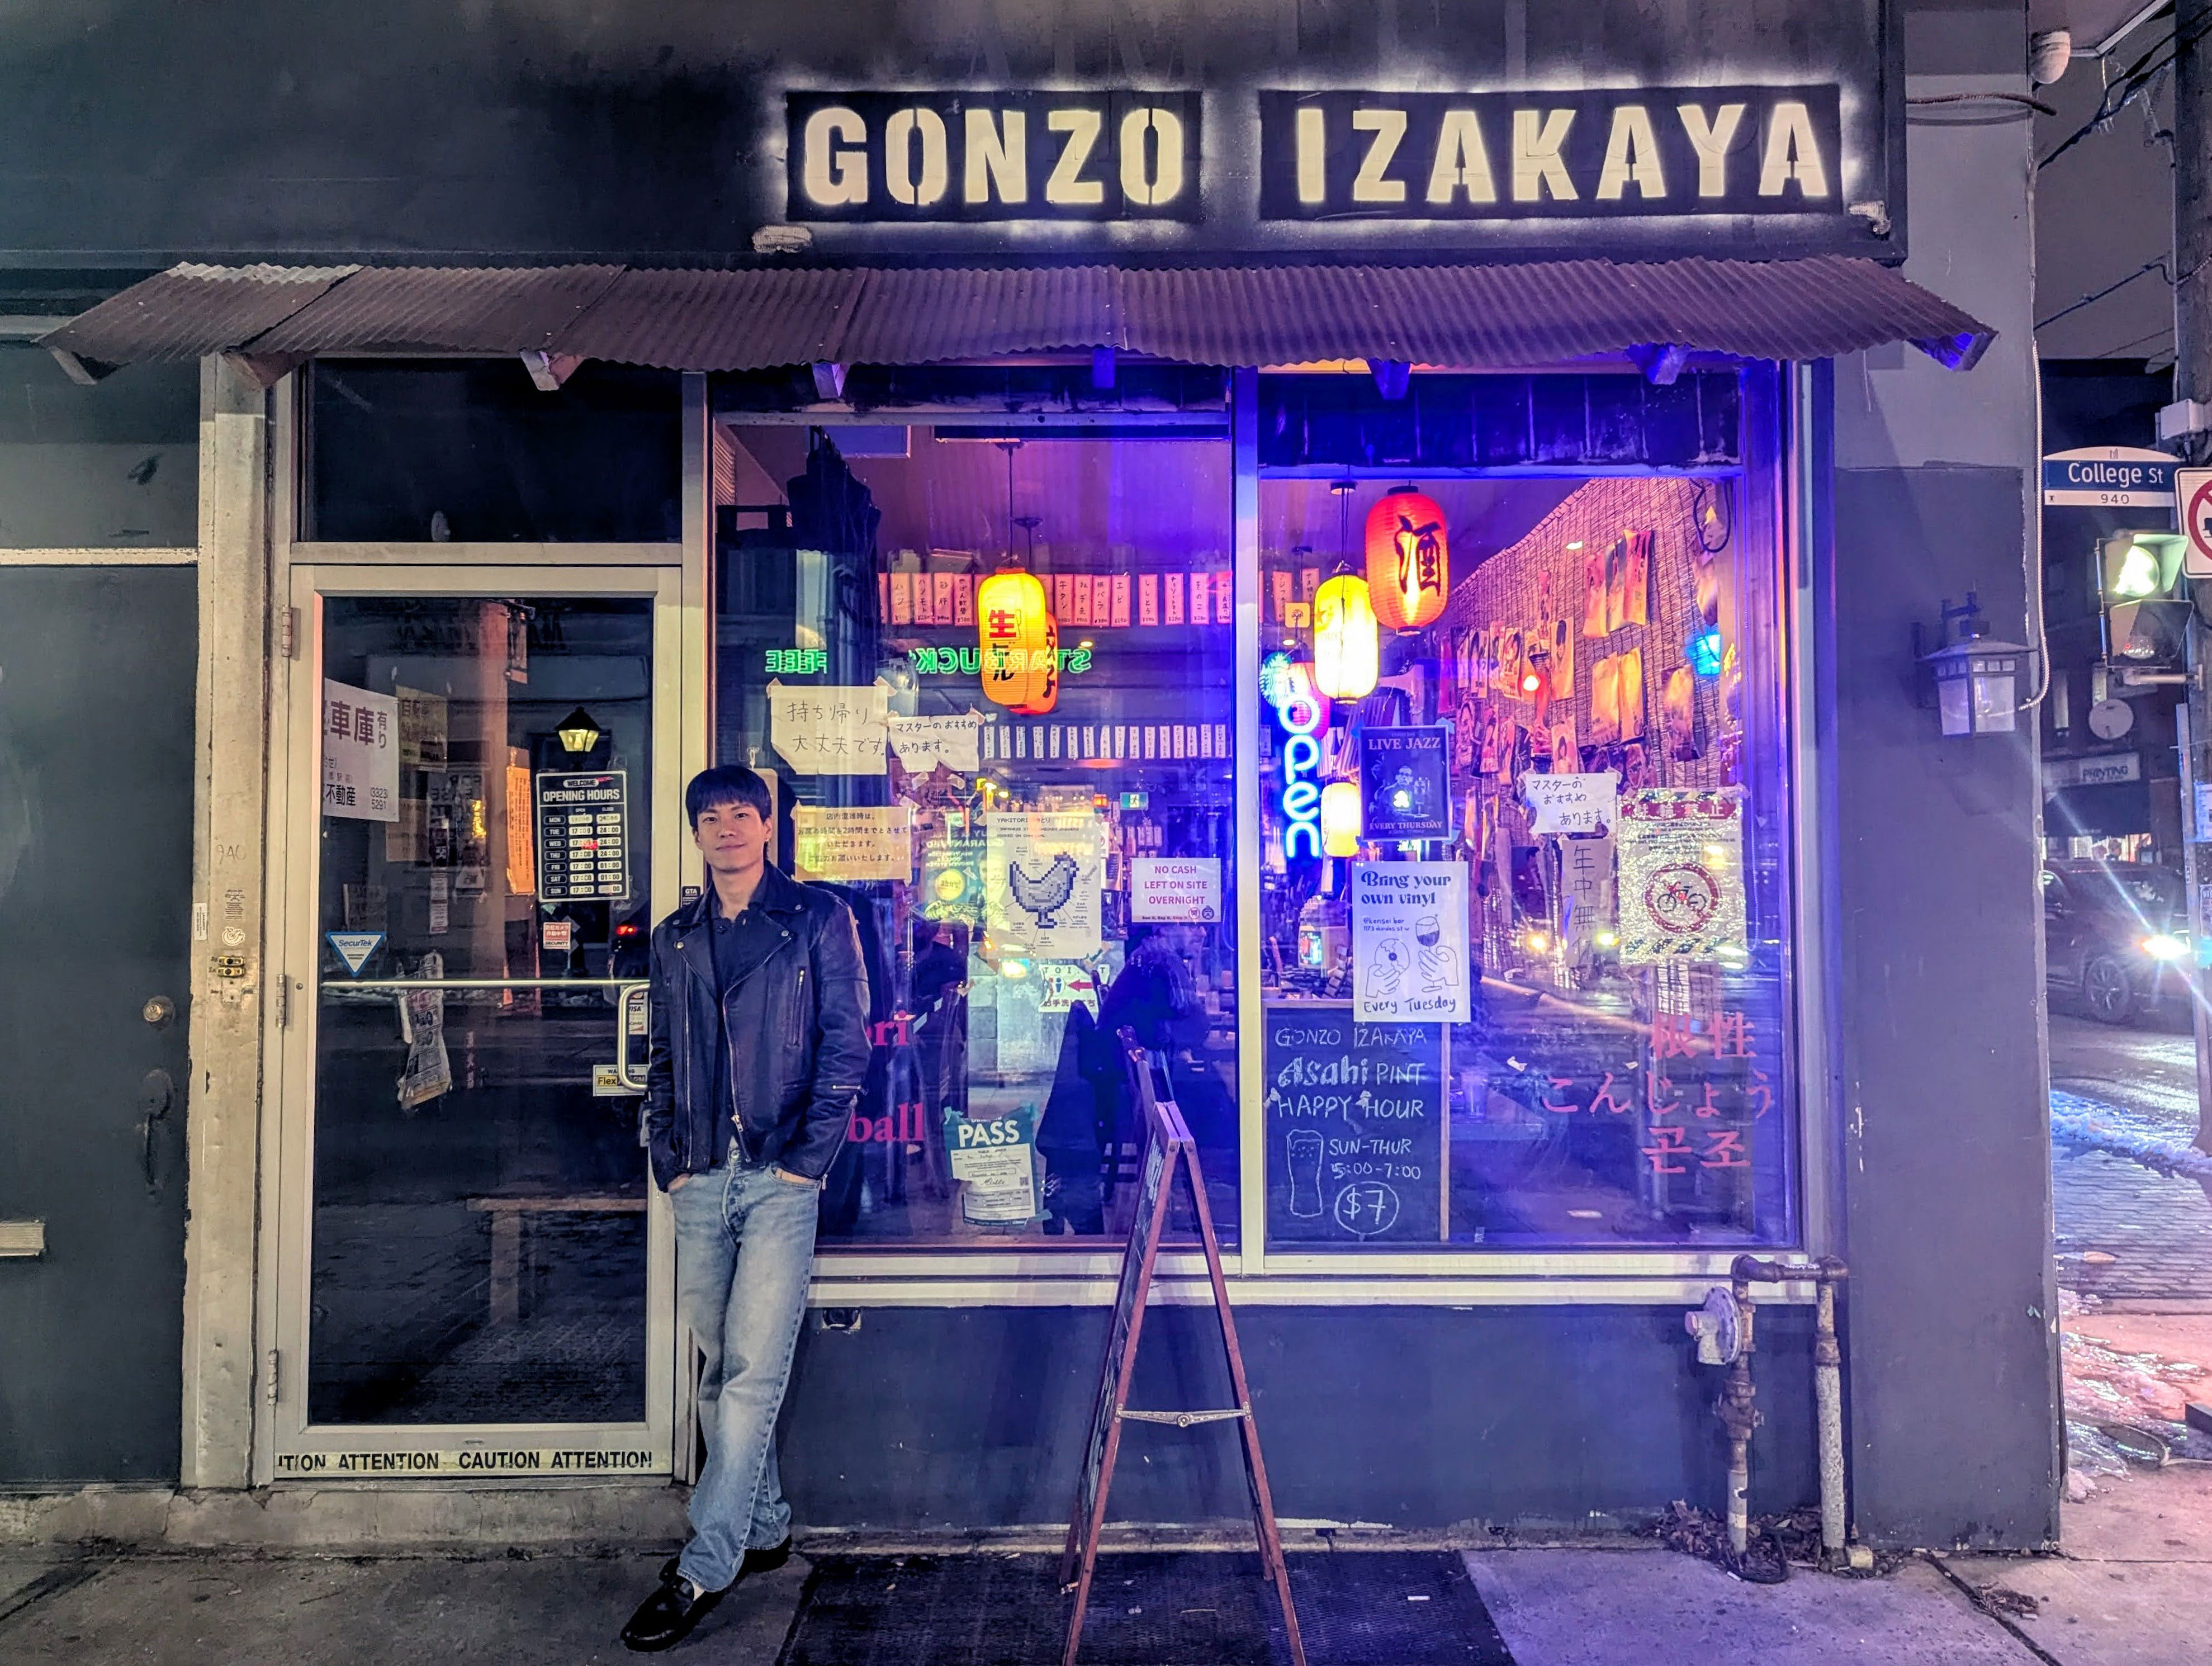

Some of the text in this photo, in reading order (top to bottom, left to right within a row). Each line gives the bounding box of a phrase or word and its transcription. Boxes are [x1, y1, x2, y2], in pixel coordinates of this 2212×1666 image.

[803, 102, 1829, 205] GONZO IZAKAYA
[2068, 462, 2163, 488] College St
[2100, 494, 2130, 504] 940
[1394, 515, 1442, 597] 酒
[787, 700, 868, 725] 持ち帰り
[330, 700, 375, 746] 車庫
[896, 720, 977, 732] マスターのおすすめ
[792, 733, 885, 756] 大丈夫です。
[899, 739, 950, 754] あります。
[1368, 737, 1441, 750] LIVE JAZZ
[326, 784, 356, 806] 不動産
[543, 788, 621, 802] OPENING HOURS
[1532, 779, 1582, 792] マスターの
[1543, 792, 1587, 805] おすすめ
[1370, 821, 1443, 830] EVERY THURSDAY
[1559, 808, 1611, 826] あります。
[1154, 865, 1197, 874] NO CASH
[1144, 881, 1207, 889] LEFT ON SITE
[1361, 870, 1452, 889] Bring your
[1149, 896, 1205, 905] OVERNIGHT
[1361, 892, 1436, 907] own vinyl
[1363, 996, 1456, 1014] Every Tuesday
[1275, 1027, 1427, 1049] GONZO IZAKAYA
[1277, 1054, 1426, 1087] Asahi PINT
[1541, 1068, 1773, 1119] こんじょう
[1278, 1094, 1424, 1121] HAPPY HOUR
[958, 1119, 1020, 1148] PASS
[1328, 1138, 1412, 1156] SUN-THUR
[1641, 1127, 1751, 1173] 곤조
[1342, 1186, 1386, 1225] $7
[338, 1452, 439, 1470] ATTENTION
[458, 1451, 540, 1469] CAUTION
[551, 1451, 652, 1469] ATTENTION
